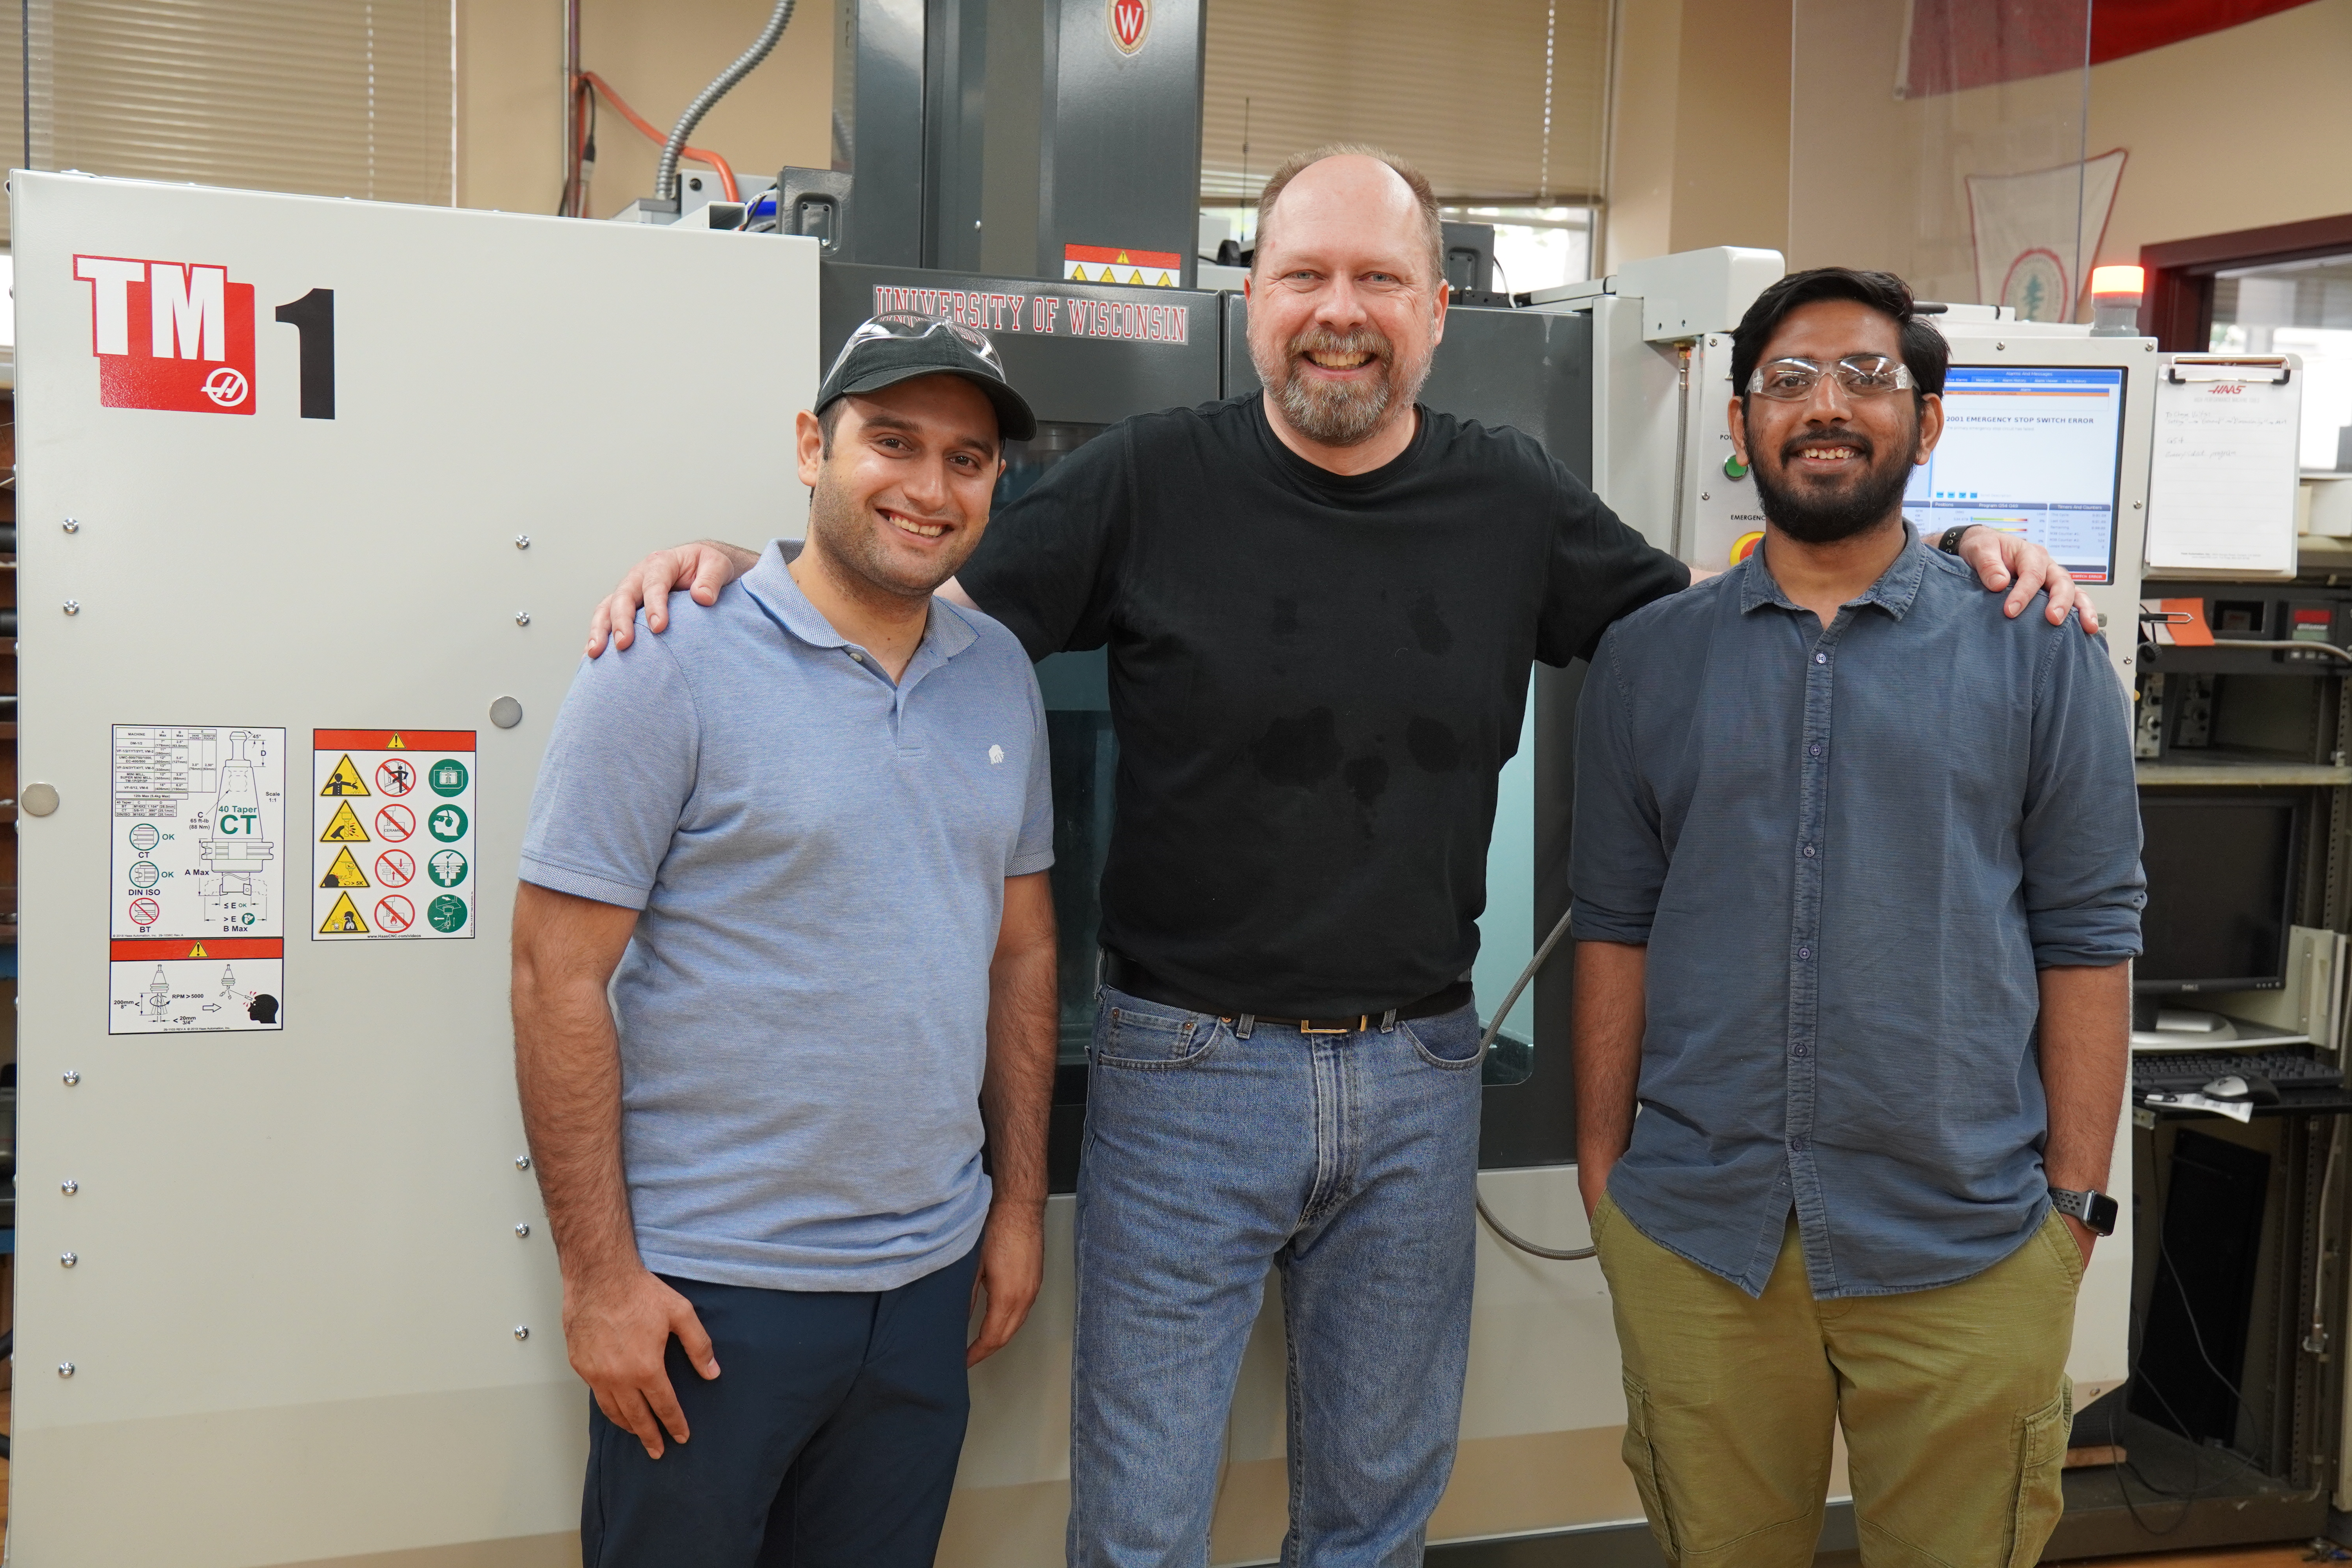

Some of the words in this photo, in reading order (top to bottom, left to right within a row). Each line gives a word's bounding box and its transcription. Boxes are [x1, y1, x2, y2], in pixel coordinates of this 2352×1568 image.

[1118, 4, 1142, 39] W
[876, 287, 1024, 331] UNIVERSITY
[1033, 296, 1059, 333] OF
[1067, 298, 1186, 342] WISCONSIN
[74, 256, 226, 362] TM
[276, 288, 334, 419] 1
[2208, 385, 2246, 394] HAAS
[232, 806, 257, 814] Taper
[220, 814, 257, 835] CT
